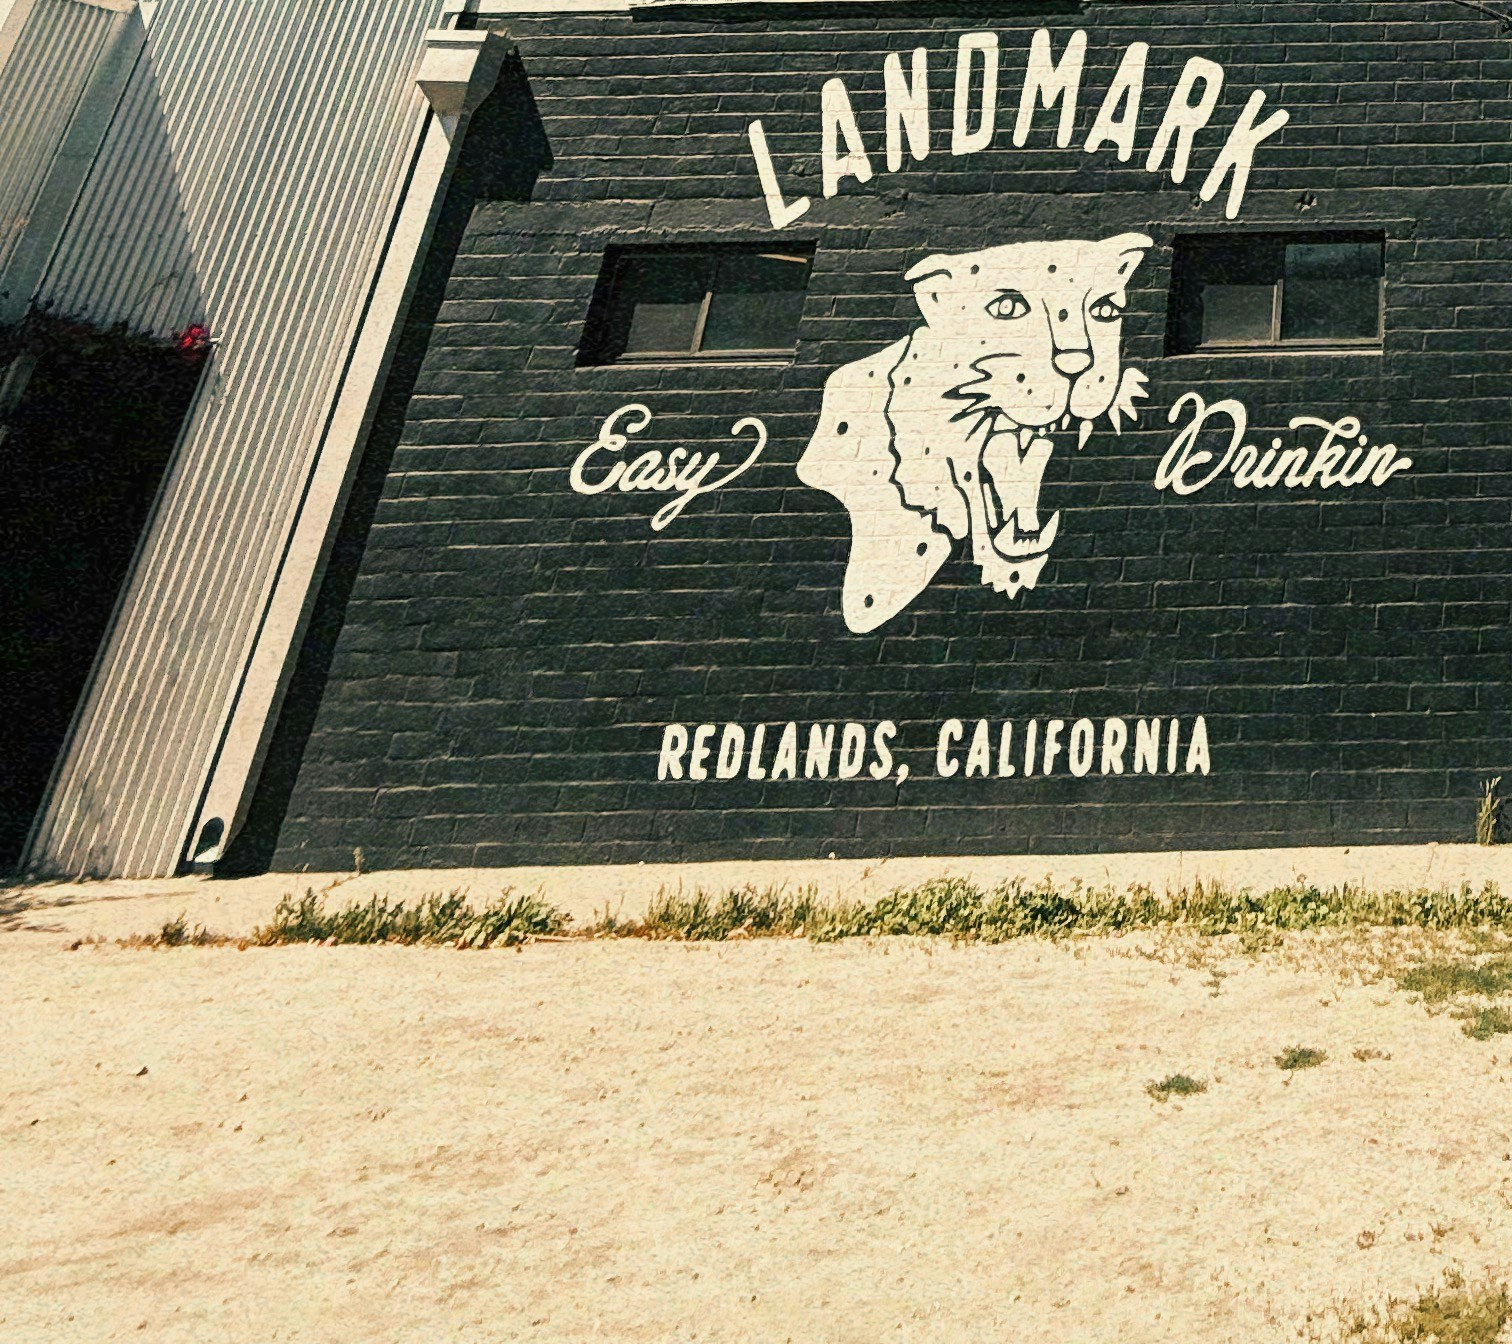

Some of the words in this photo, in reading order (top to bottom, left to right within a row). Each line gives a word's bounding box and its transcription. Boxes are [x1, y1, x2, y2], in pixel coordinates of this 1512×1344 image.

[746, 27, 1291, 231] LANDMARK
[569, 403, 768, 532] Easy
[1153, 391, 1414, 496] Drinkin
[657, 720, 909, 786] REDLANDS,
[936, 715, 1211, 778] CALIFORNIA
